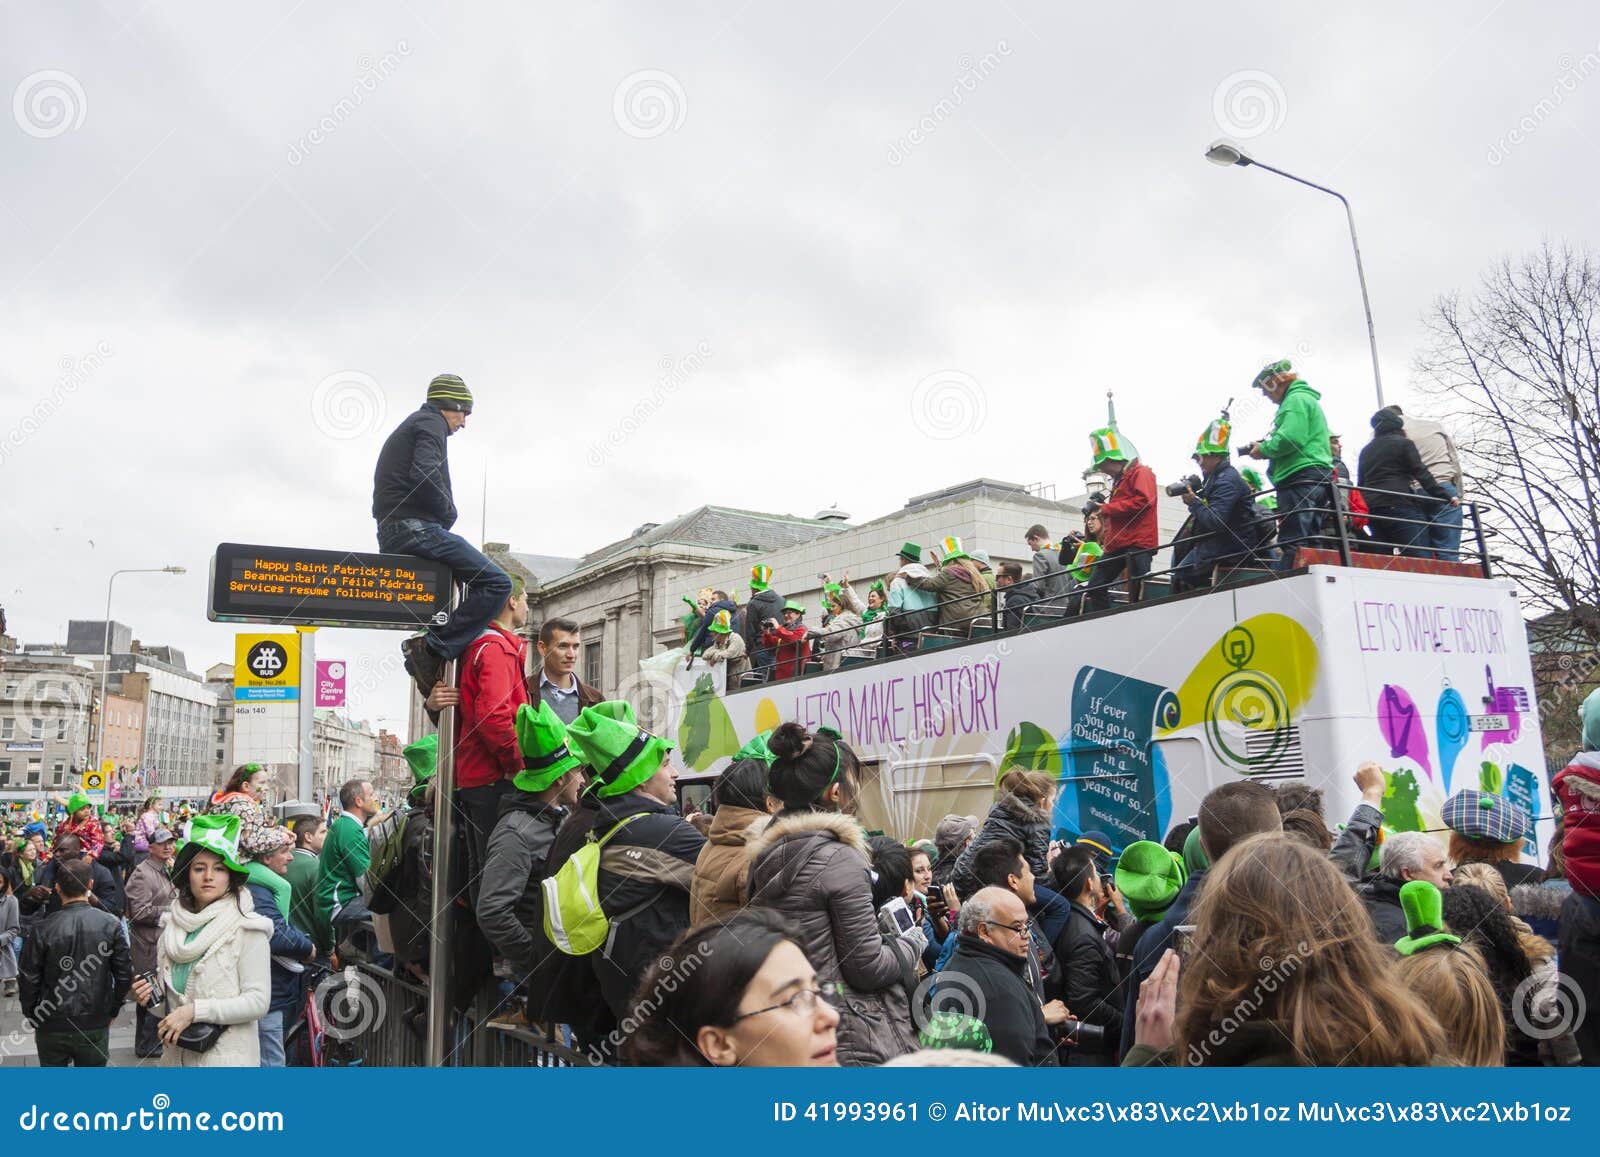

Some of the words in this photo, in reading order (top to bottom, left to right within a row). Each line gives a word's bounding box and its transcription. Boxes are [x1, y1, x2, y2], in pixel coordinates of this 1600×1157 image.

[255, 559, 290, 573] Happy
[295, 562, 328, 573] Saint
[333, 564, 391, 577] Patrick's
[395, 568, 416, 581] Day
[323, 576, 337, 585] na
[342, 576, 375, 588] Féile
[230, 580, 284, 593] Services
[289, 586, 330, 596] resume
[336, 587, 393, 601] following
[397, 591, 435, 602] parade
[1353, 601, 1401, 652] LET'S
[1403, 604, 1452, 653] MAKE
[1451, 606, 1507, 655] HISTORY
[320, 680, 334, 689] City
[849, 677, 906, 746] MAKE
[913, 660, 1001, 740] HISTORY
[1090, 696, 1104, 715] If
[1103, 704, 1127, 720] ever
[1073, 723, 1112, 749] Dublin
[1080, 713, 1104, 729] you
[1106, 723, 1120, 737] go
[1123, 726, 1135, 741] to
[1104, 753, 1116, 767] in
[1118, 760, 1126, 770] a
[1082, 778, 1112, 798] years
[1113, 791, 1127, 803] or
